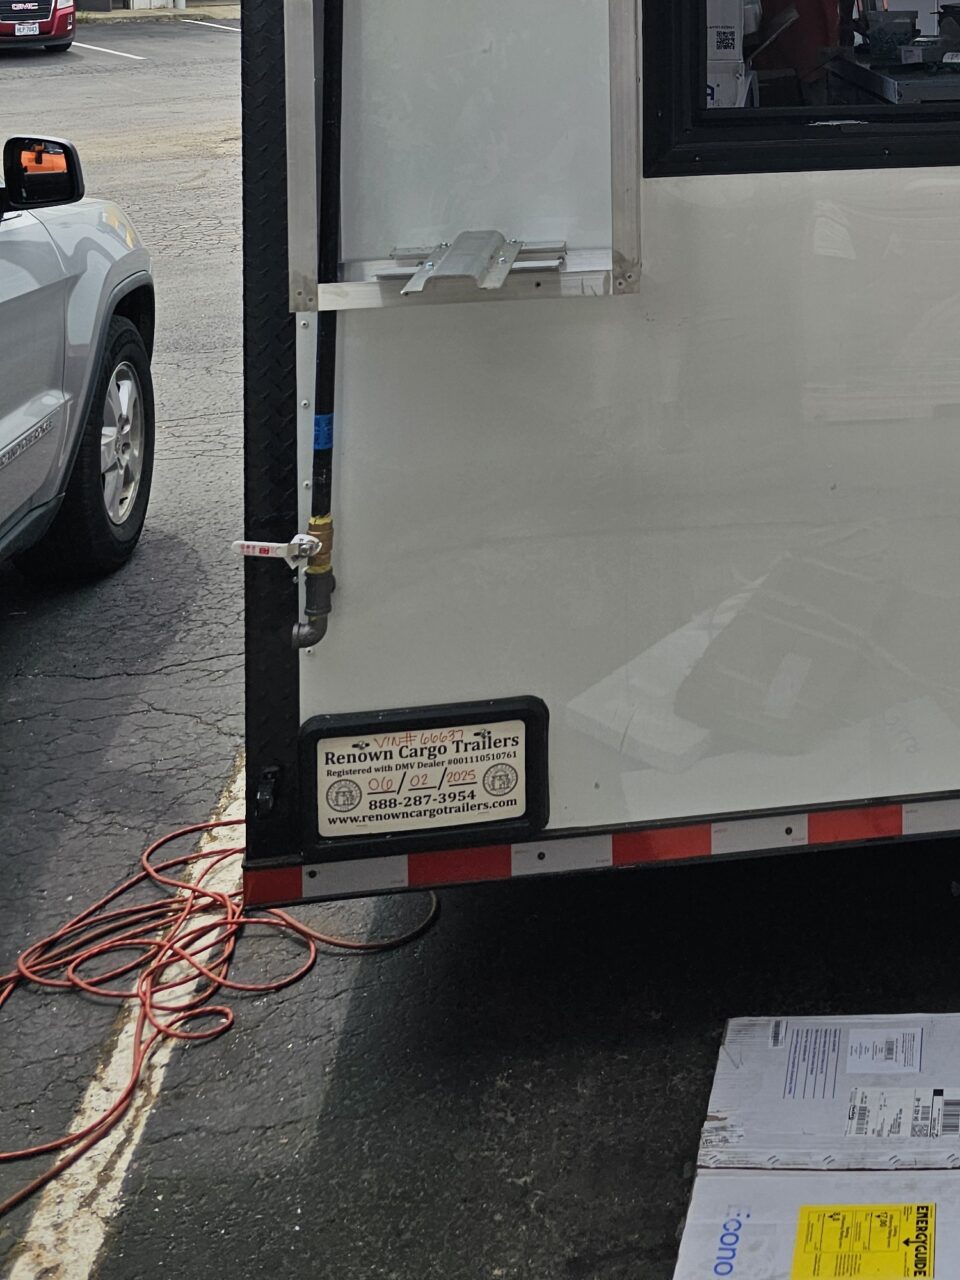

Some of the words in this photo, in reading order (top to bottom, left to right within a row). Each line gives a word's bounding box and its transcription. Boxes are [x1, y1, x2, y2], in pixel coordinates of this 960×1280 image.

[324, 748, 394, 766] Renown
[398, 742, 448, 760] Cargo
[452, 734, 520, 753] Trailers
[326, 766, 372, 777] Registered
[374, 763, 393, 772] with
[395, 761, 416, 771] DMV
[417, 759, 446, 769] Dealer
[327, 797, 518, 826] www.renowncargotrailers.com
[368, 789, 477, 811] 888-287-3954
[912, 1205, 929, 1278] ENERGYGUIDE
